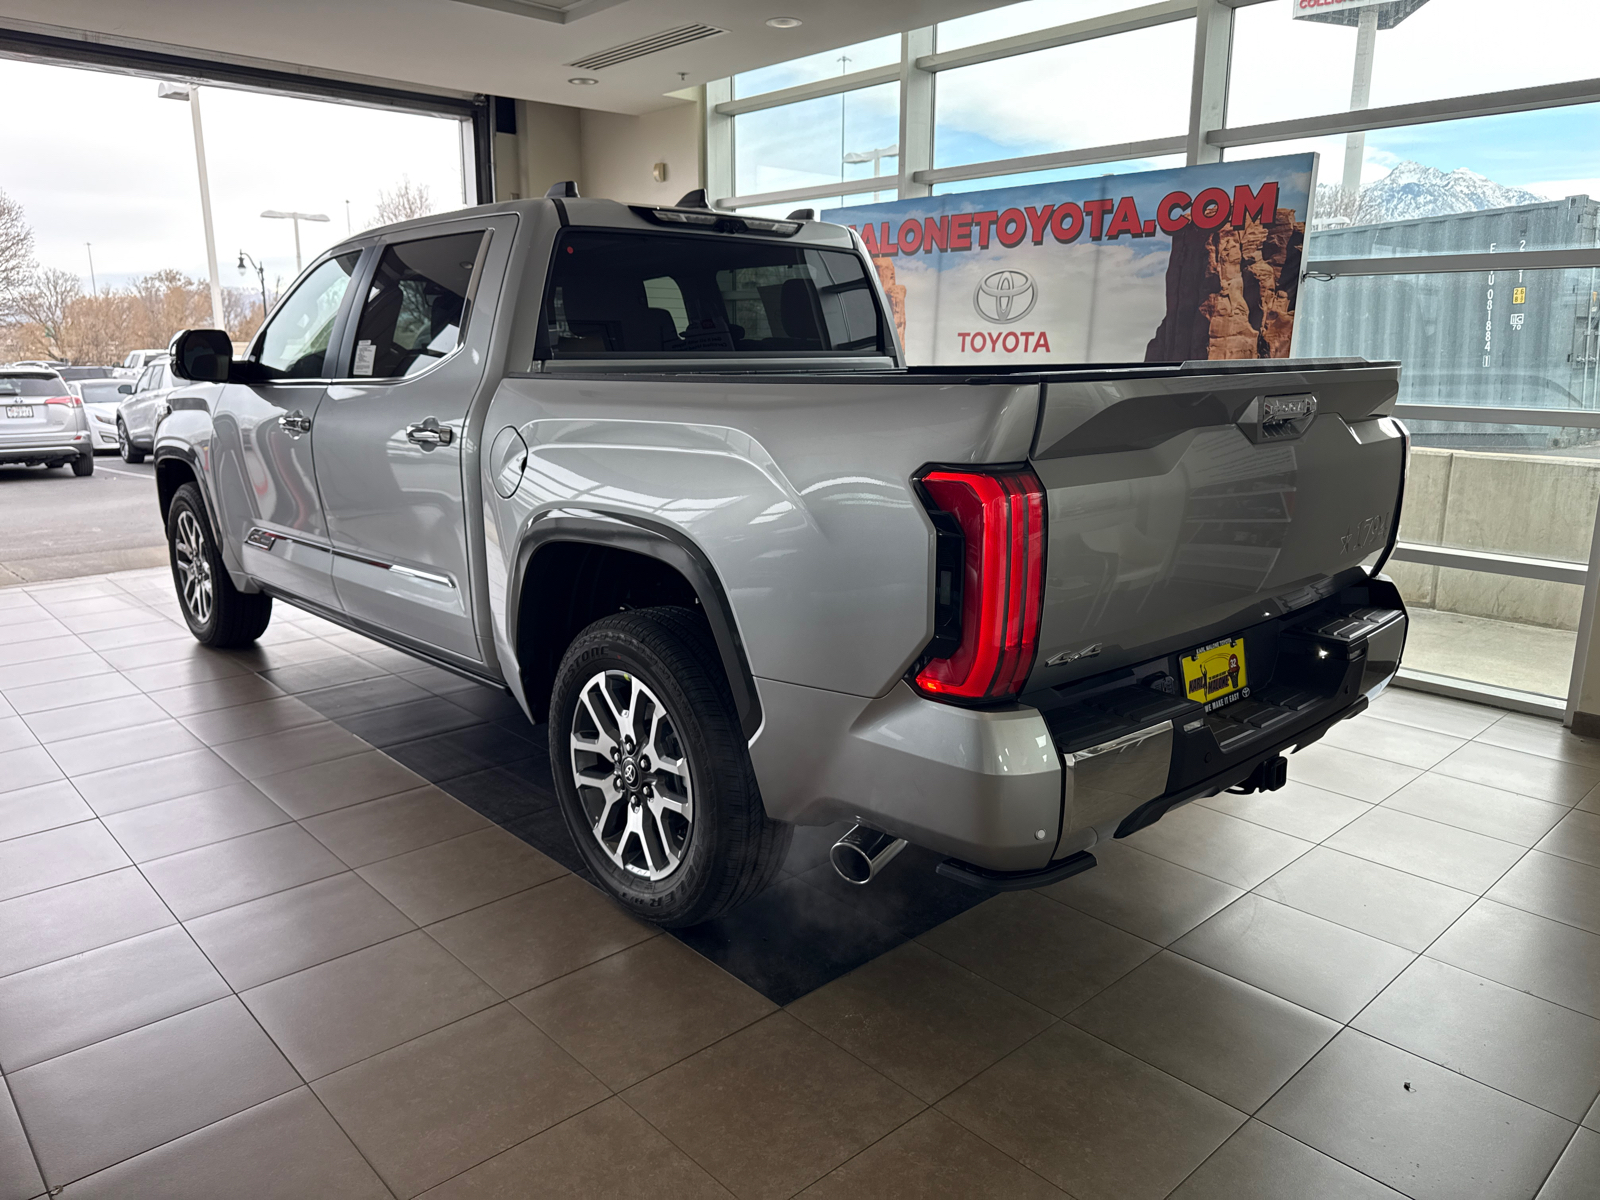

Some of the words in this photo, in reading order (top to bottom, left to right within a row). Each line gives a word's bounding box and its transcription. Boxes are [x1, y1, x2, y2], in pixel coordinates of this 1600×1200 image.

[848, 181, 1279, 258] ALONETOYOTA.COM
[957, 331, 1051, 353] TOYOTA
[1230, 658, 1237, 668] 32
[1204, 703, 1212, 713] WE
[1212, 699, 1224, 710] MAKE
[1229, 692, 1239, 703] EASY
